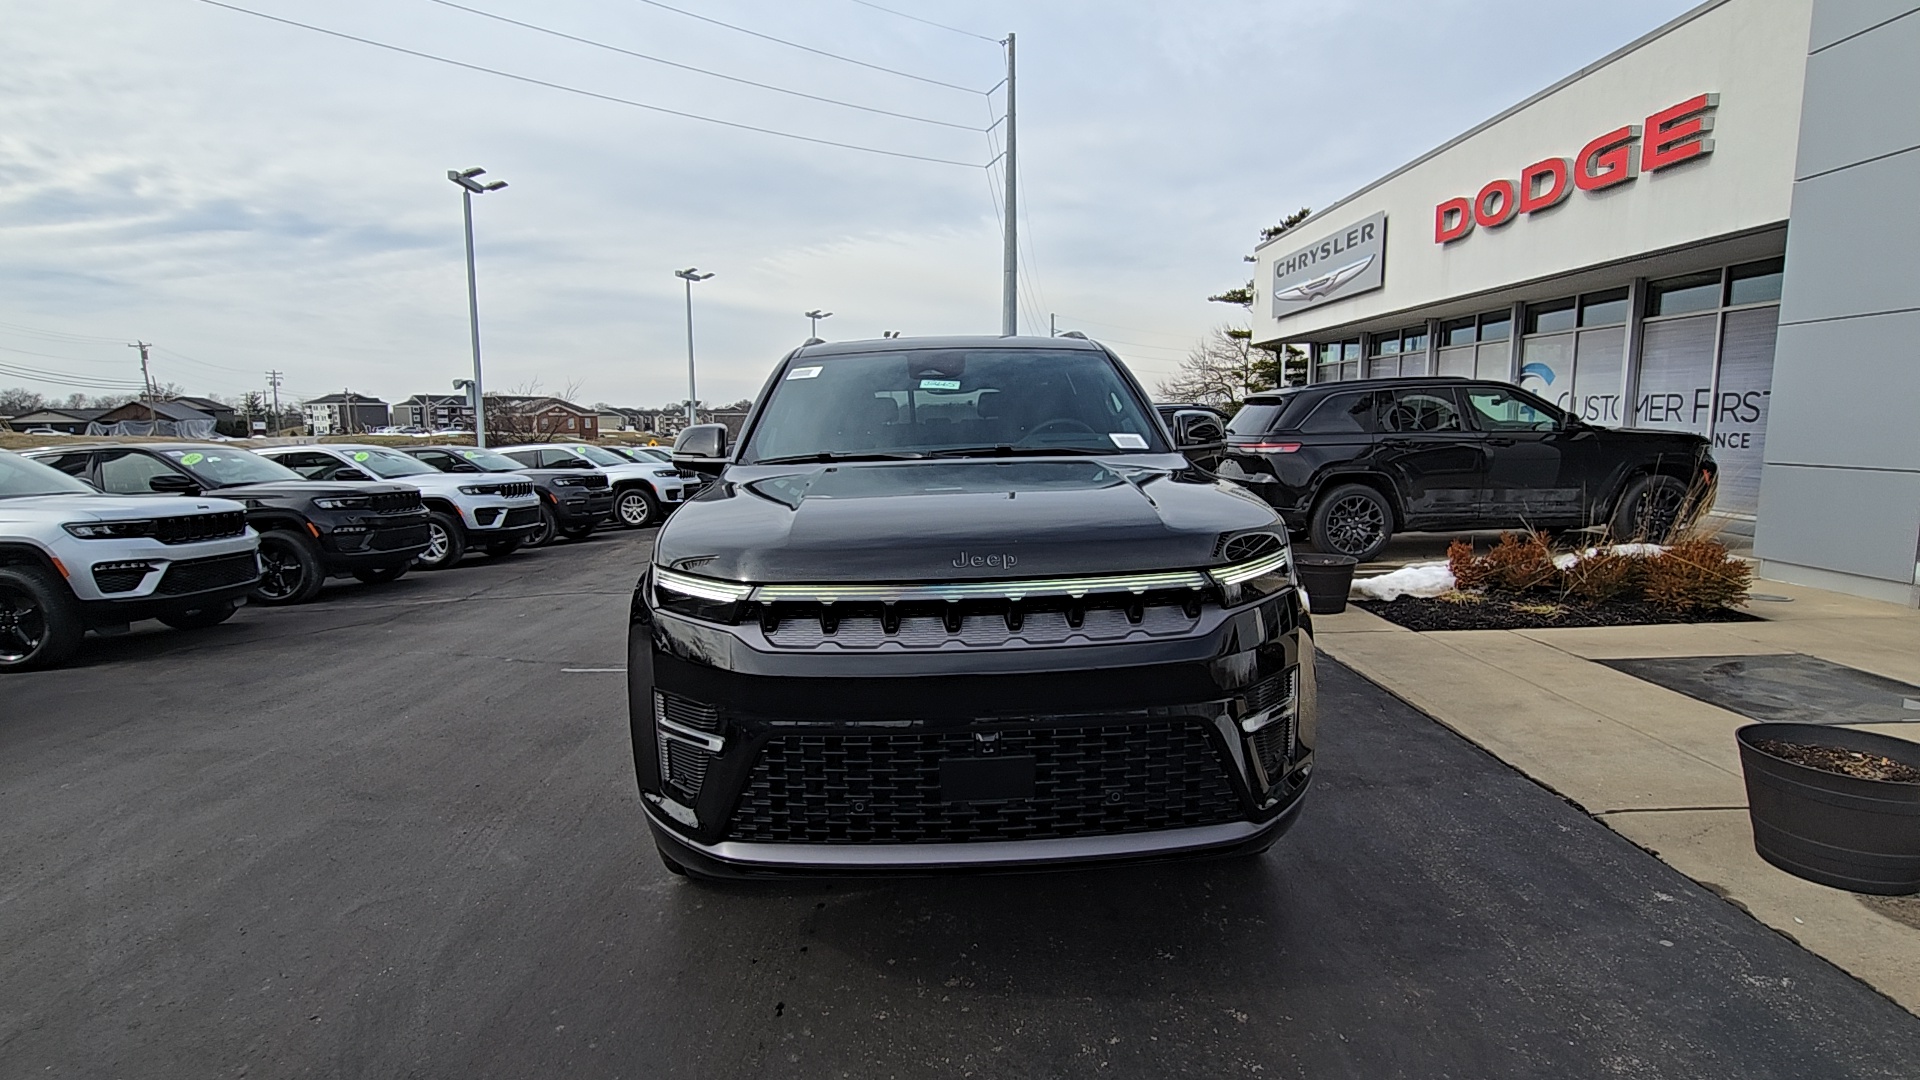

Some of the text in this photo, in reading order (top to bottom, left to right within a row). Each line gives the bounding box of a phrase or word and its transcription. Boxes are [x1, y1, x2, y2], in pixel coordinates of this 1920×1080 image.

[1435, 93, 1719, 244] DODGE
[1276, 222, 1375, 279] CHRYSLER
[952, 551, 1018, 570] Jeep
